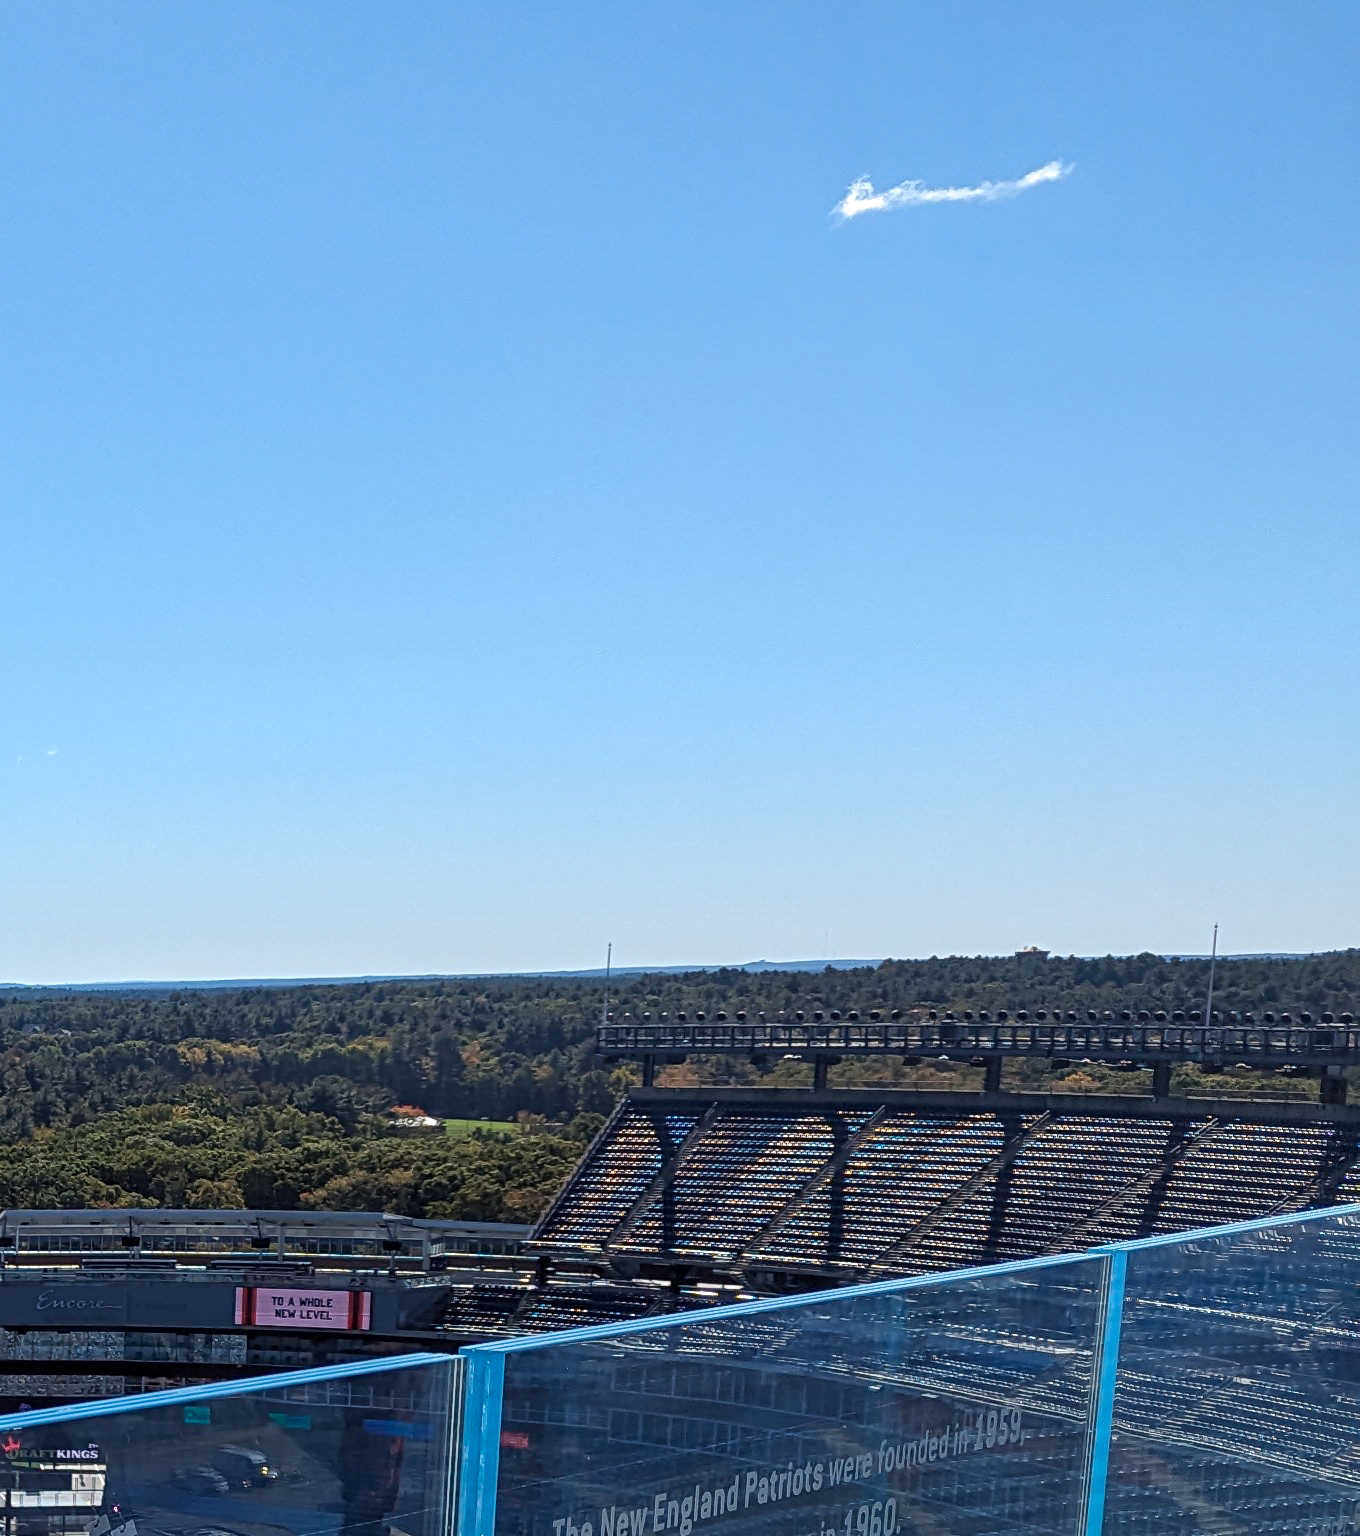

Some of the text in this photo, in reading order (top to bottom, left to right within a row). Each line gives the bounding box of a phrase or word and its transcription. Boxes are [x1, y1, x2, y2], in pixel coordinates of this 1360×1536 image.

[36, 1289, 123, 1310] Encore
[272, 1296, 333, 1308] TO A WHOLE
[275, 1309, 333, 1320] NEW LEVEL
[5, 1449, 99, 1460] DRAFTKINGS
[653, 1475, 740, 1536] England
[745, 1461, 823, 1508] Patriots
[830, 1452, 873, 1487] were
[878, 1424, 950, 1474] founded
[953, 1422, 968, 1456] in
[974, 1407, 1024, 1451] 1959,
